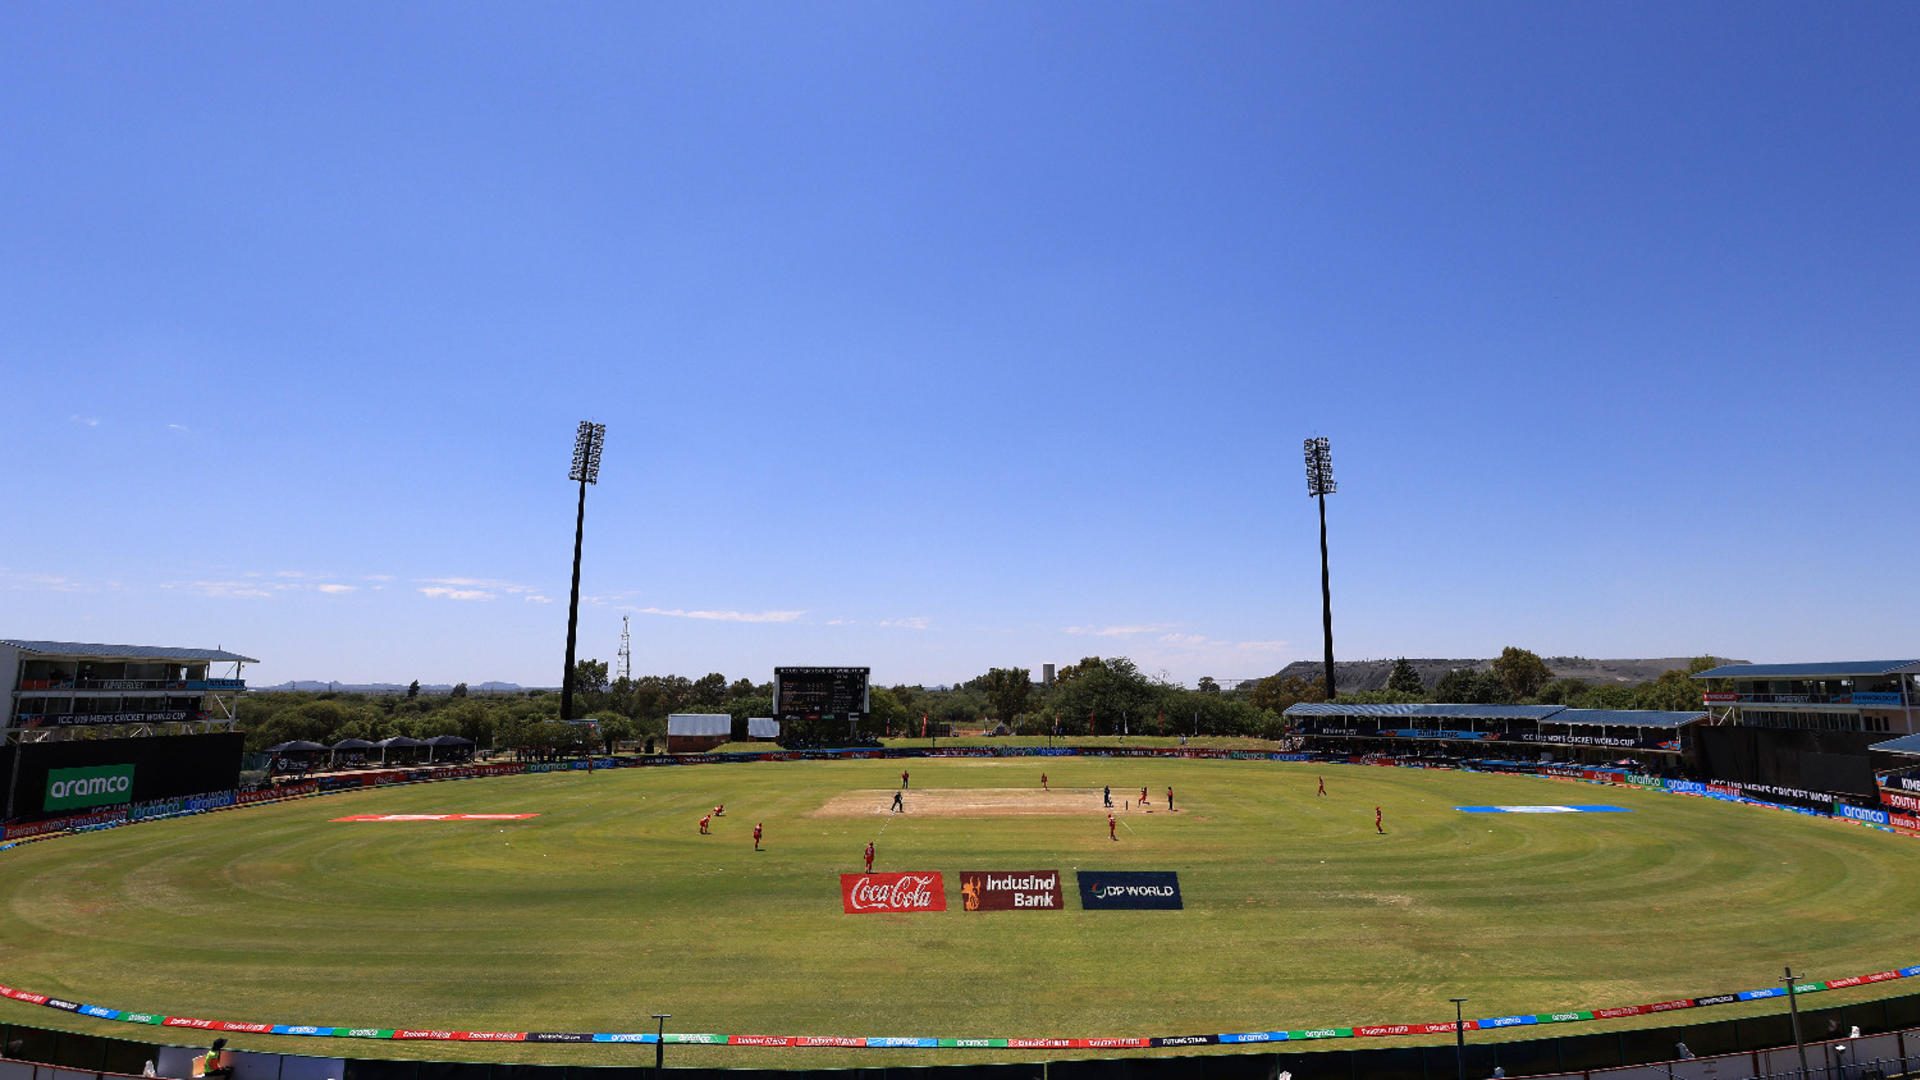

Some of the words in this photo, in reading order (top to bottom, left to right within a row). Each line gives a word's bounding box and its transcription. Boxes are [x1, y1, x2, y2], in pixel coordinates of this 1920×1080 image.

[57, 715, 74, 725] ICC
[90, 714, 113, 724] MEN'S
[114, 713, 146, 722] CRICKET
[146, 712, 172, 721] WORLD
[172, 712, 186, 720] CUP
[1594, 736, 1619, 746] WORLD
[1619, 738, 1636, 748] CUP
[51, 776, 130, 798] aramco
[1627, 774, 1661, 787] aramco
[1666, 779, 1702, 792] aramco
[1743, 782, 1771, 794] MEN'S
[1772, 786, 1809, 800] CRICKET
[190, 795, 230, 811] aramco
[1889, 794, 1917, 810] SOUTH
[134, 802, 180, 819] aramco
[1843, 805, 1885, 823] aramco
[986, 874, 1056, 892] IndusInd
[1106, 885, 1126, 897] DP
[1126, 884, 1175, 897] WORLD
[851, 873, 935, 910] Coca-Cola
[1014, 891, 1054, 908] Bank
